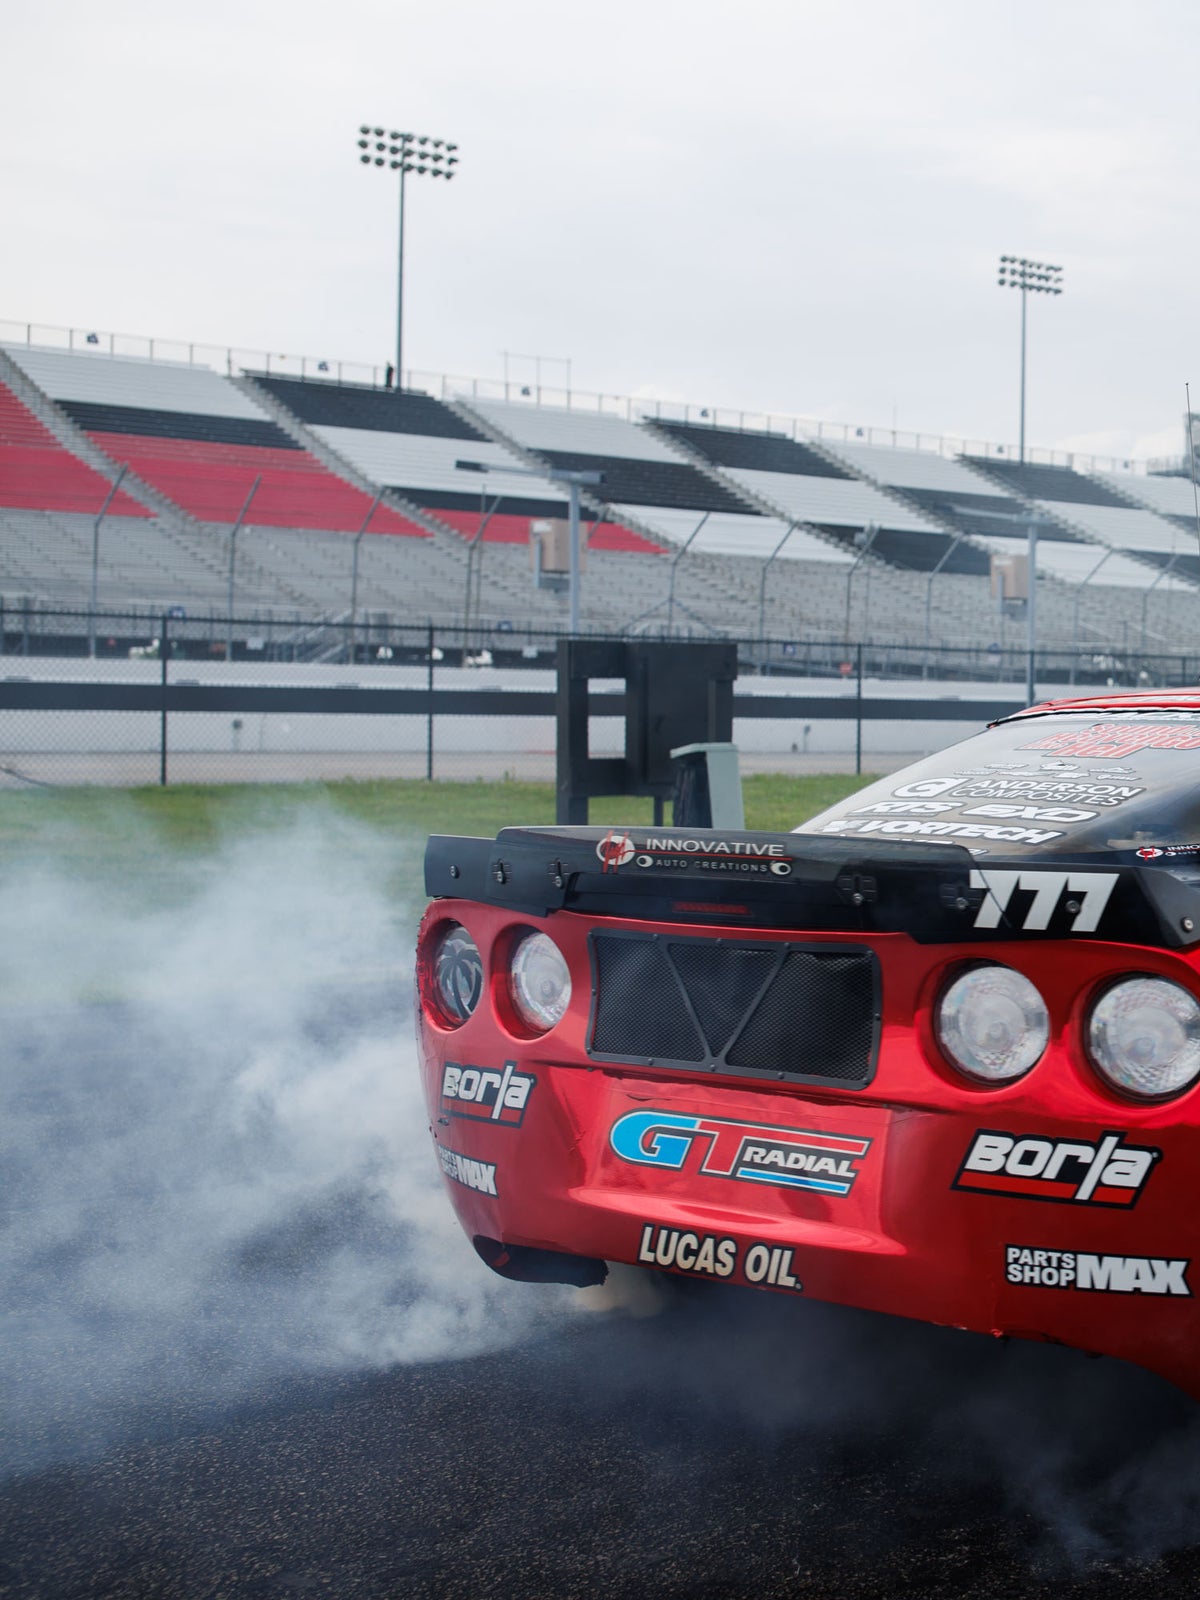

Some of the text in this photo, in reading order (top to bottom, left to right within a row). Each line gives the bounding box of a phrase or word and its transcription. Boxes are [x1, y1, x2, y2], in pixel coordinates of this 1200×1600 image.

[952, 788, 1122, 806] COMPOSITES
[967, 780, 1144, 797] ANDERSON
[852, 801, 964, 813] RTS
[858, 820, 1064, 844] VORTECH
[646, 838, 785, 857] INNOVATIVE
[655, 858, 769, 873] AUTO CREATIONS
[969, 869, 1121, 932] 777
[610, 1110, 870, 1178] GT RADIAL
[456, 1155, 498, 1196] MAX
[639, 1226, 798, 1288] LUCAS OIL
[1007, 1246, 1192, 1296] PARTS MAX
[1007, 1263, 1076, 1287] SHOP
